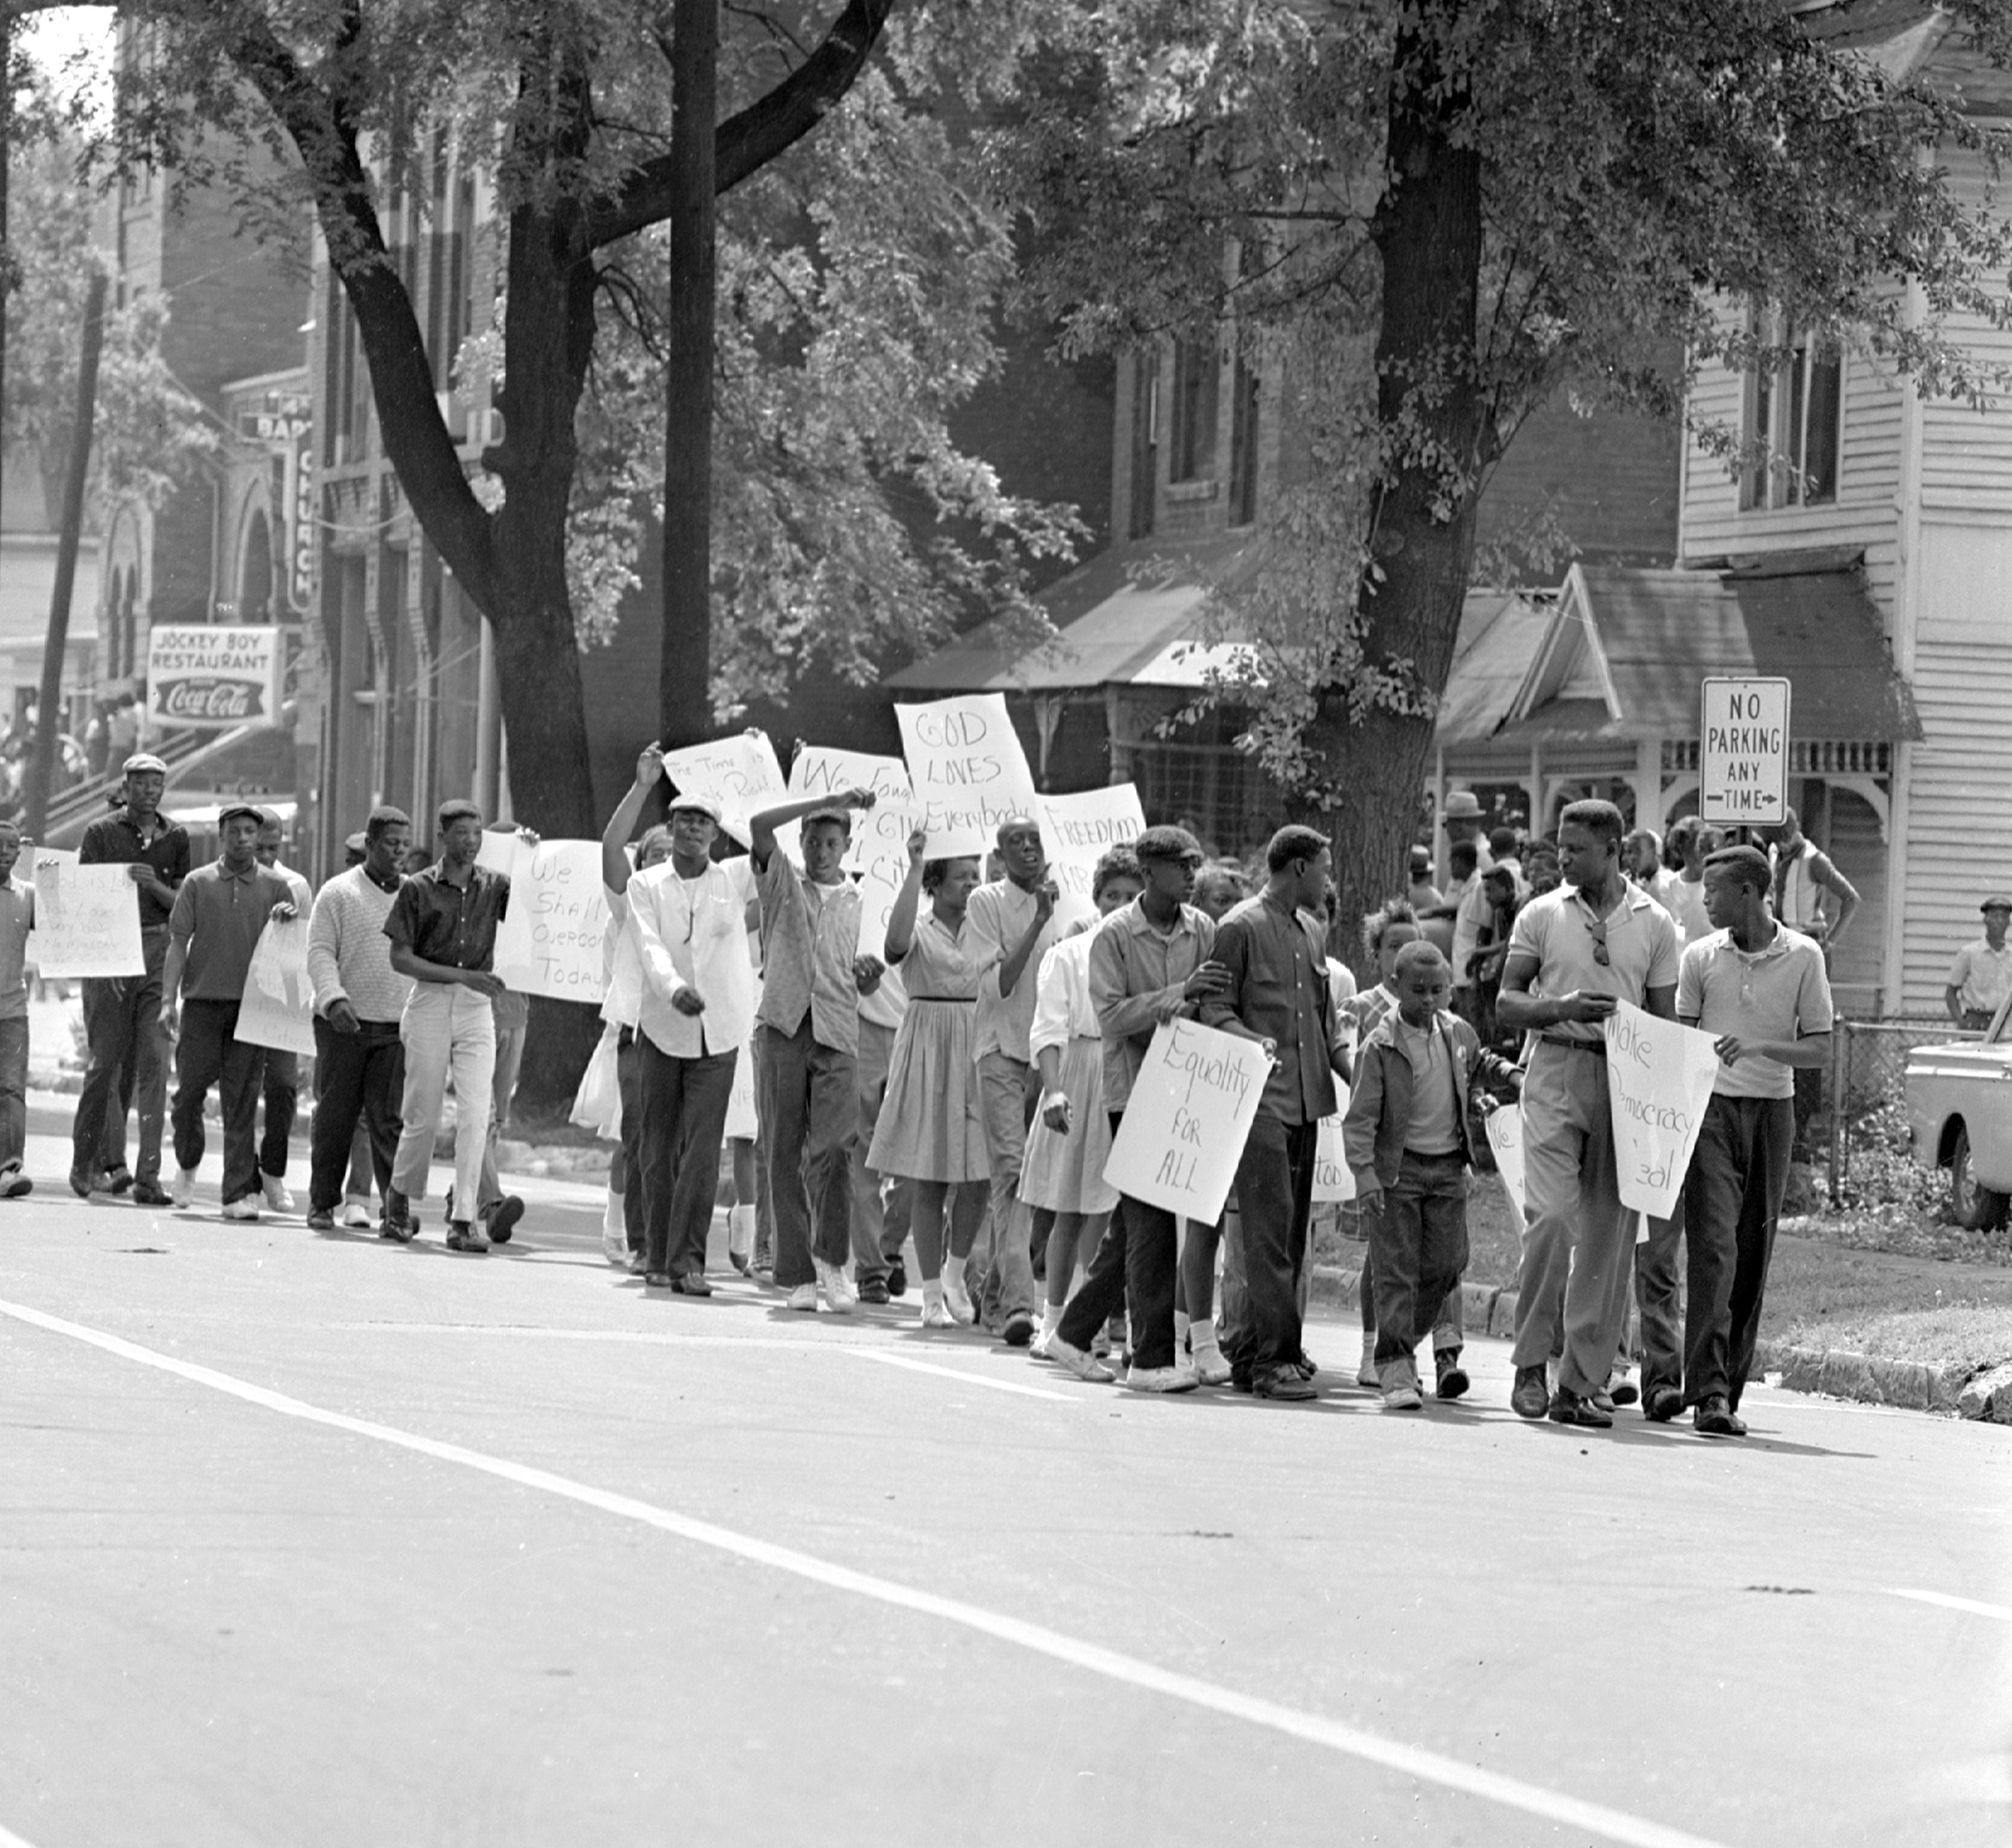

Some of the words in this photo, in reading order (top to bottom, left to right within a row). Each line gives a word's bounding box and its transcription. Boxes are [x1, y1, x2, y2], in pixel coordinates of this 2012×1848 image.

[156, 633, 219, 649] JOCKEY
[227, 633, 260, 650] BOY
[152, 653, 268, 669] RESTAURANT
[1730, 693, 1760, 720] NO
[916, 711, 987, 747] GOD
[1708, 728, 1780, 754] PARKING
[695, 756, 735, 773] Time
[927, 754, 1001, 785] LOVES
[1728, 762, 1760, 782] ANY
[803, 758, 850, 794] We
[869, 766, 911, 807] Foug
[1724, 789, 1763, 809] TIME
[530, 854, 572, 884] We
[1164, 1025, 1250, 1120] Equality
[1171, 1106, 1202, 1148] FOR
[1156, 1149, 1196, 1194] ALL
